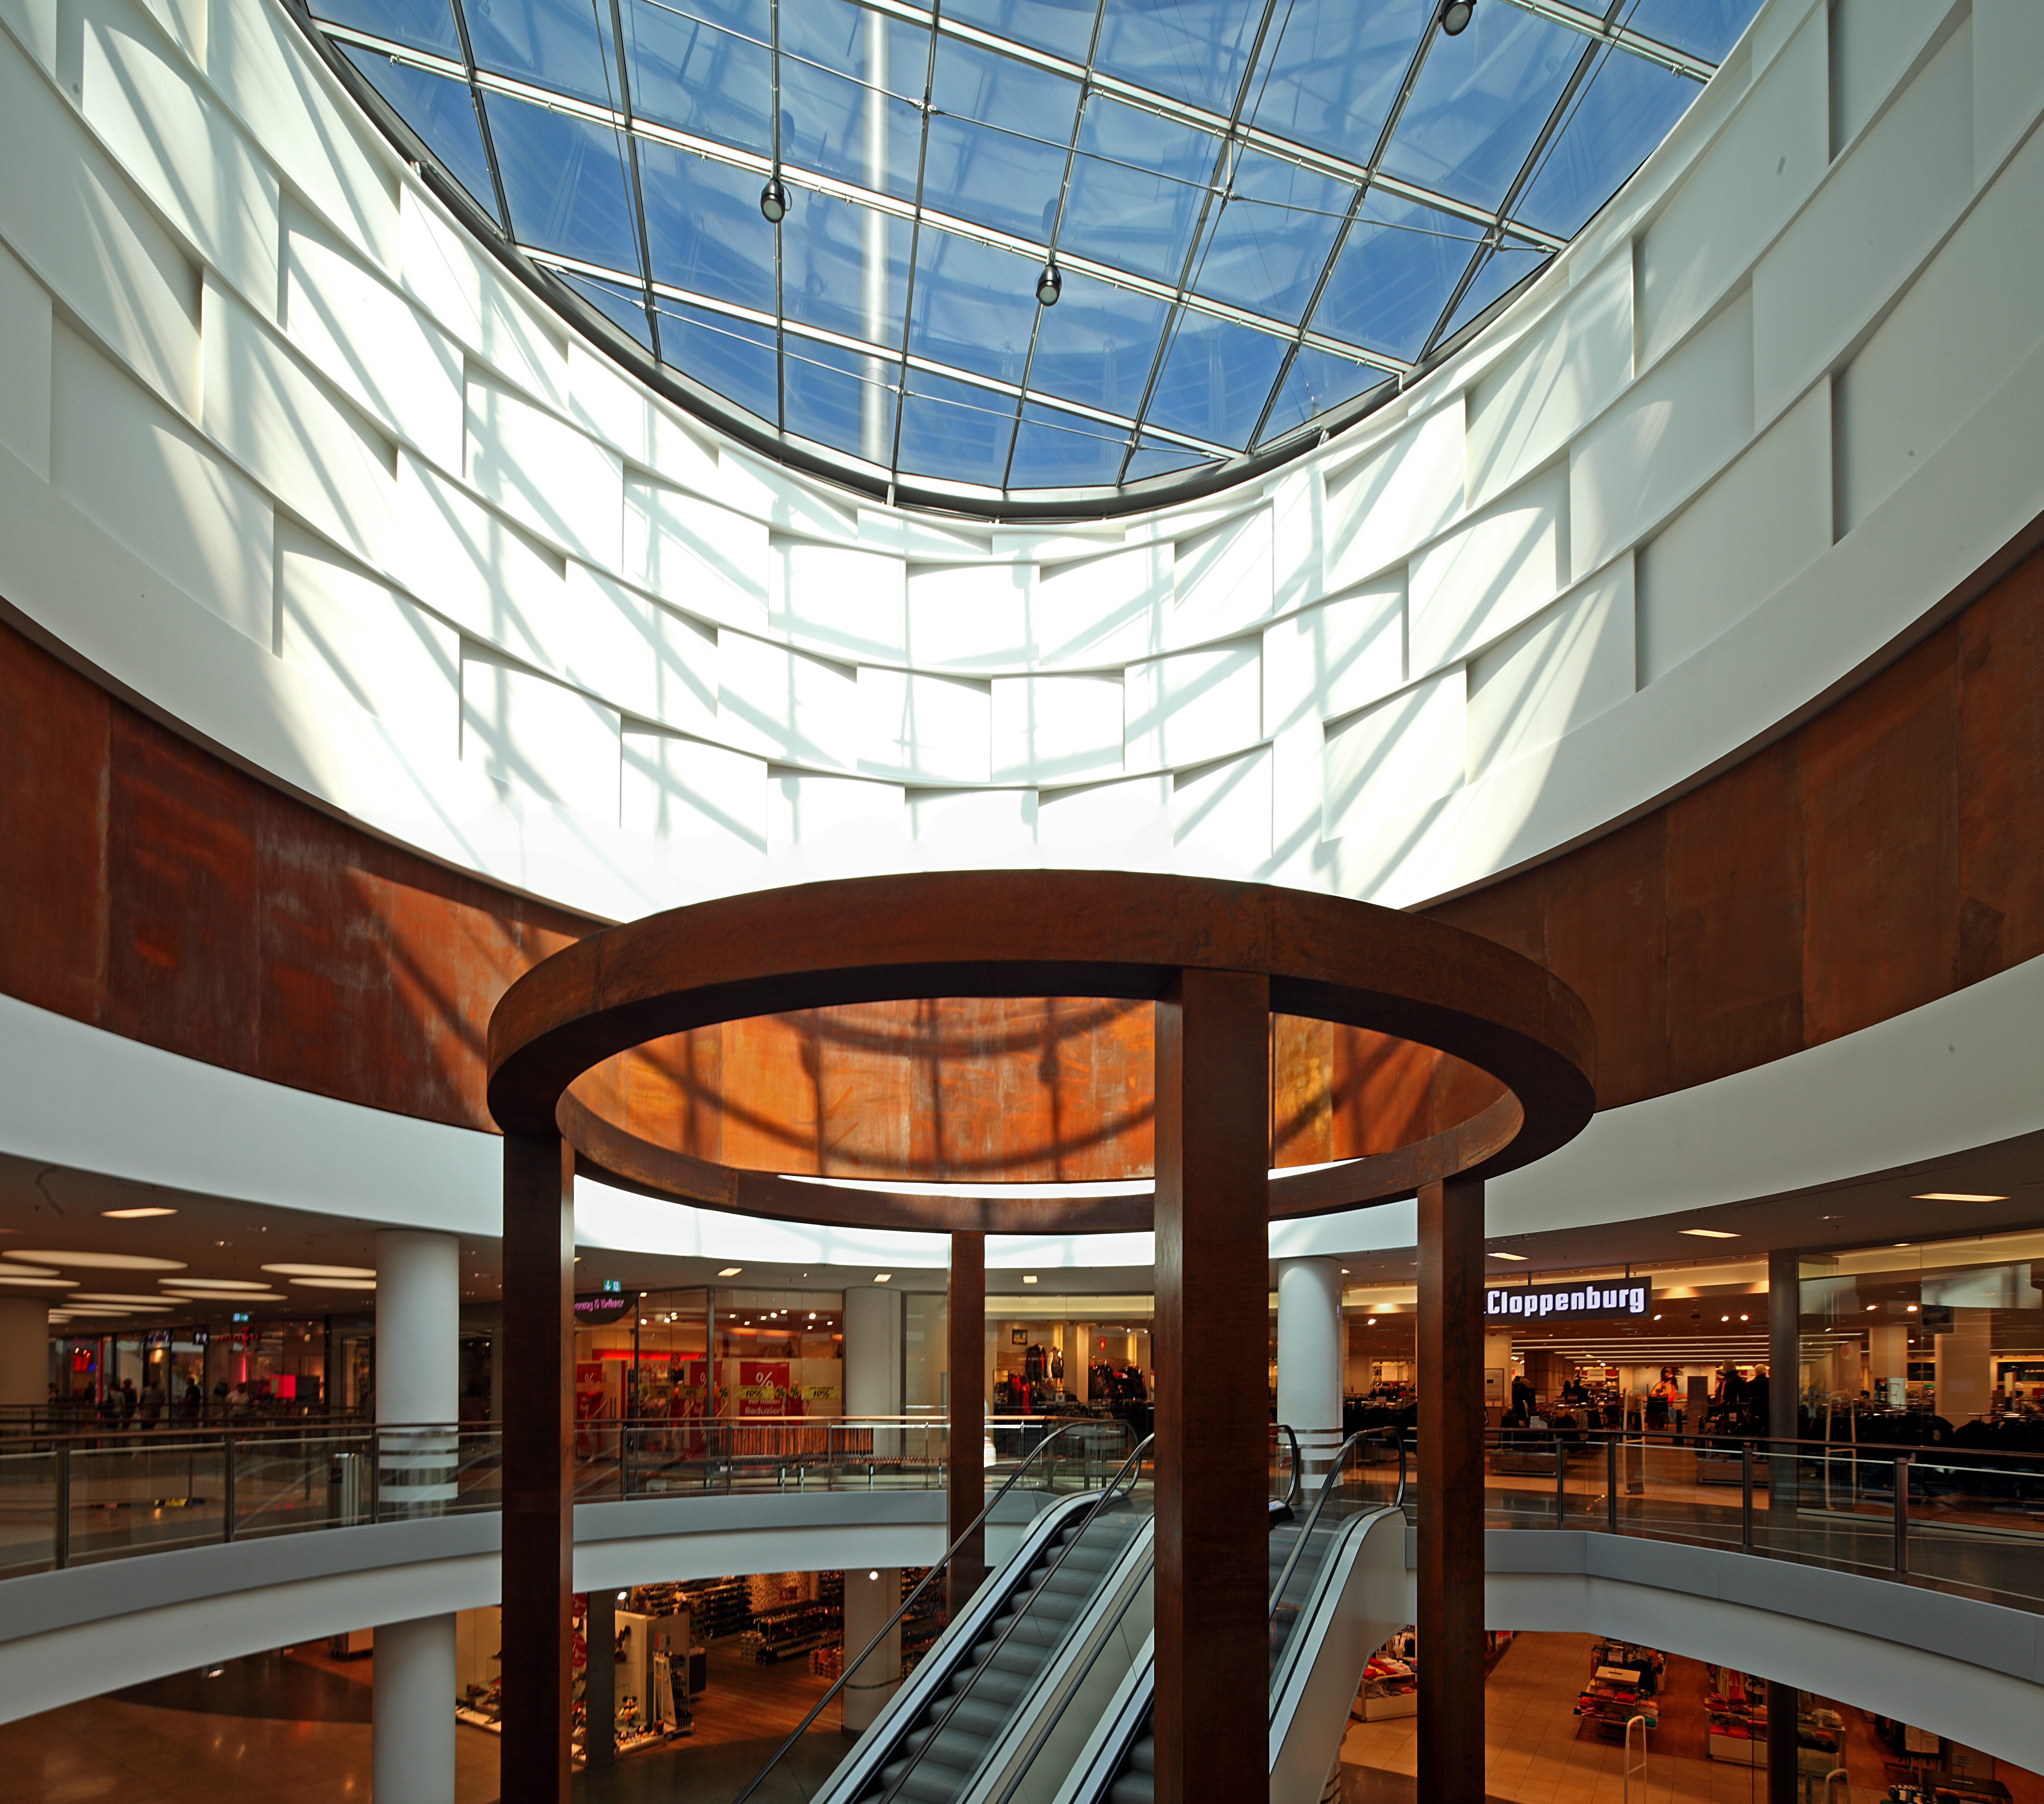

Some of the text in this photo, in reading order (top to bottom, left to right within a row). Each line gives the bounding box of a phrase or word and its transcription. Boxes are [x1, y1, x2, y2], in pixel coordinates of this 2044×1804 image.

[1488, 1286, 1645, 1317] Cloppenburg
[574, 1302, 593, 1312] erzog
[745, 1406, 782, 1416] Reduzier
